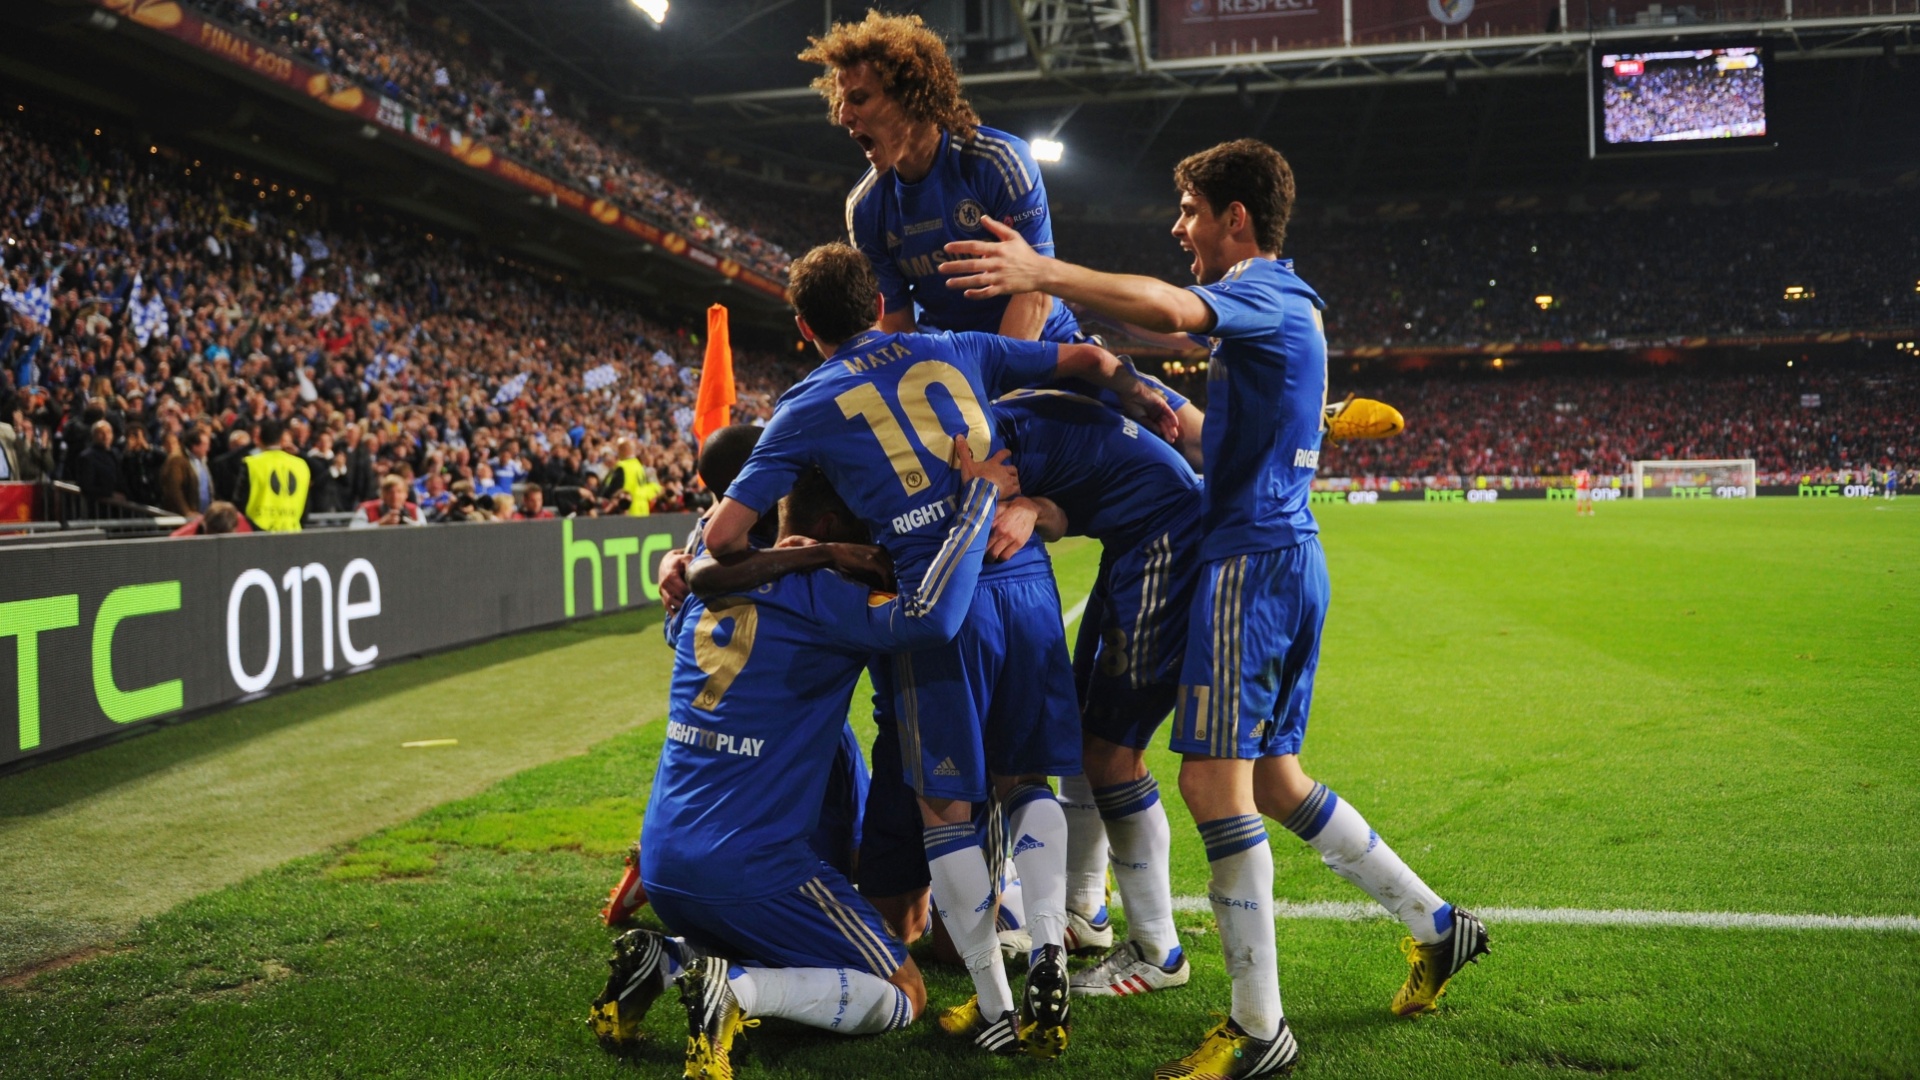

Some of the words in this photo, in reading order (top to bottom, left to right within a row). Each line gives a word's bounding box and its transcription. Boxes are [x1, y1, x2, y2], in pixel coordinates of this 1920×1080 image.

[201, 21, 250, 62] FINAL
[255, 46, 292, 79] 2013
[1013, 206, 1045, 223] RESPECT
[842, 342, 912, 375] MATA
[834, 359, 992, 497] 10
[1347, 490, 1379, 505] one
[1467, 489, 1499, 503] one
[1590, 487, 1622, 501] one
[1716, 486, 1747, 500] one
[1843, 485, 1875, 498] one
[892, 500, 946, 535] RIGHT
[226, 557, 382, 694] one
[691, 597, 758, 712] 9
[1101, 627, 1129, 677] 8
[932, 767, 961, 776] adidas
[1244, 900, 1259, 911] FC
[831, 1016, 842, 1028] FC
